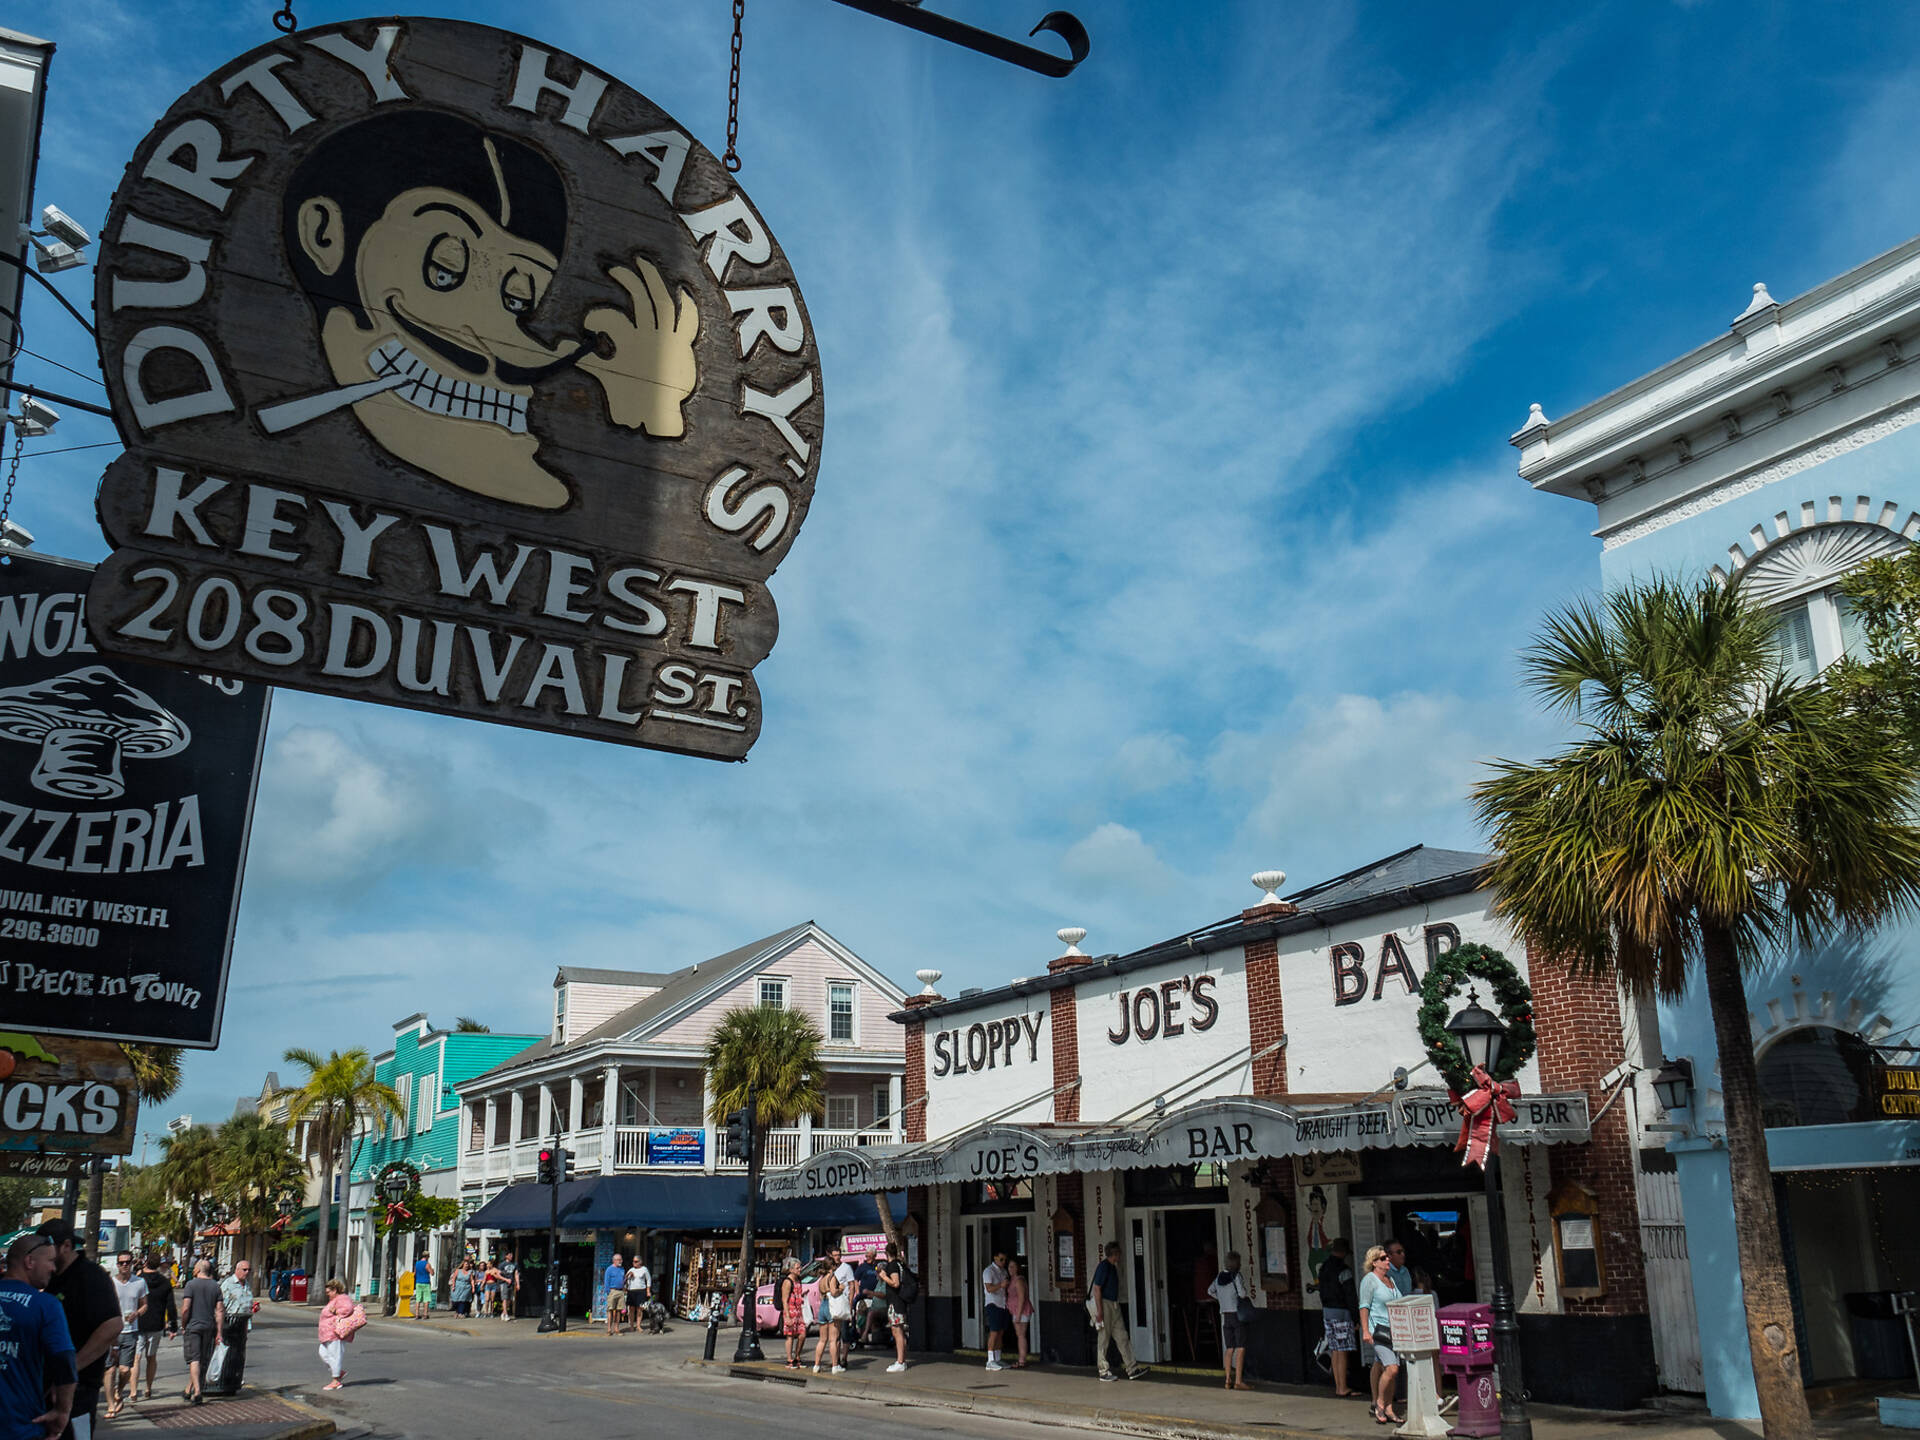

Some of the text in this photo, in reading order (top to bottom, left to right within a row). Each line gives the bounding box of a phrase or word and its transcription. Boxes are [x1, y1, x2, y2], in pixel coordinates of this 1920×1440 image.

[112, 25, 813, 551] DURTY HARRY'S
[144, 466, 744, 649] KEY WEST
[118, 567, 749, 724] 208 DUVAL ST.
[933, 922, 1471, 1077] SLOPPY JOE'S BAR
[0, 1081, 120, 1134] CK'S
[1404, 1102, 1459, 1129] SLOPP
[1530, 1102, 1571, 1125] BAR
[1187, 1123, 1257, 1159] BAR
[1296, 1111, 1389, 1142] DRAUGHT BEER
[806, 1162, 871, 1190] SLOPPY
[970, 1144, 1039, 1177] JOE'S
[1521, 1145, 1545, 1308] NTERTAINMENT
[1443, 1325, 1463, 1335] Florida
[1446, 1336, 1461, 1346] Keys
